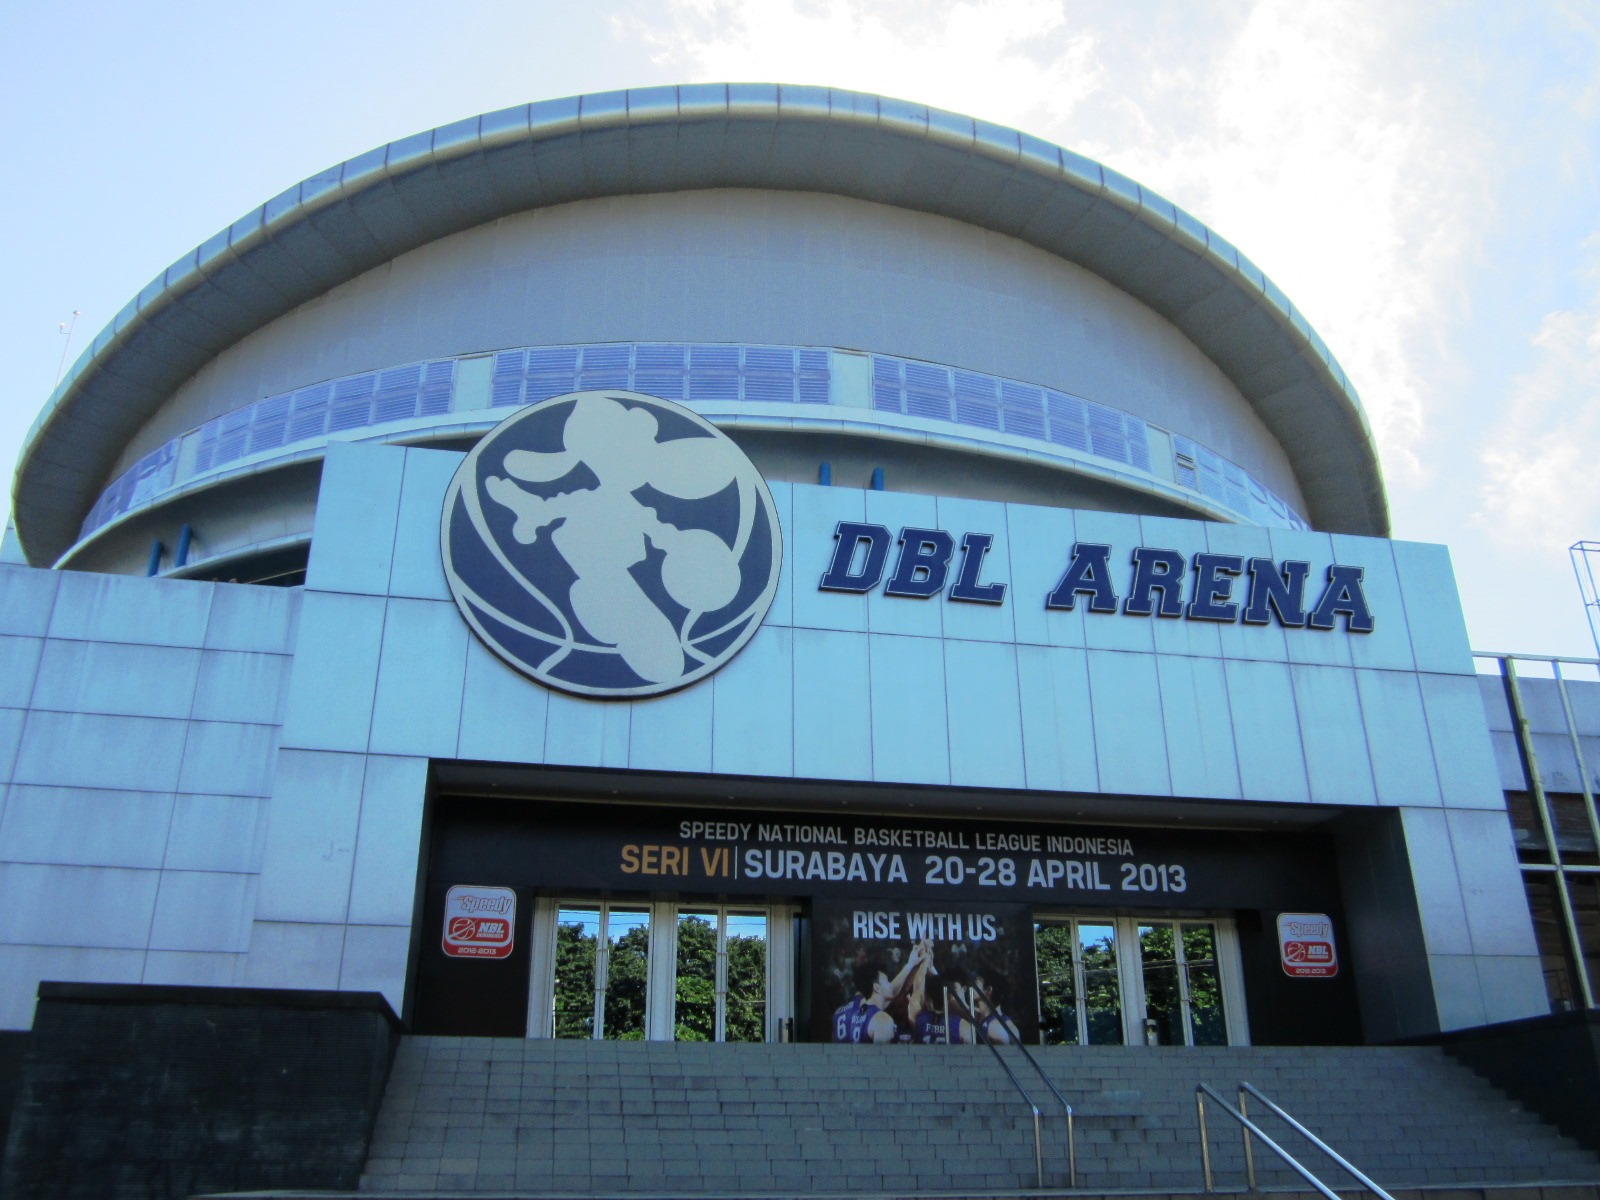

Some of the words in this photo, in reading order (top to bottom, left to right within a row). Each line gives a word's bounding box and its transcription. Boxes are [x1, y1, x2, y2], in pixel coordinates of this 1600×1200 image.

[818, 520, 1007, 605] DBL
[1047, 542, 1375, 633] ARENA
[679, 821, 752, 841] SPEEDY
[758, 824, 848, 845] NATIONAL
[854, 827, 970, 849] BASKETBALL
[976, 833, 1041, 852] LEAGUE
[1047, 836, 1134, 856] INDONESIA
[620, 844, 689, 876] SERI
[700, 847, 729, 877] VI
[744, 849, 908, 883] SURABAYA
[925, 855, 1017, 887] 20-28
[1027, 859, 1111, 891] APRIL
[1120, 863, 1187, 893] 2013
[460, 895, 512, 914] Speedy
[478, 922, 504, 933] NBL
[853, 911, 901, 940] RISE
[906, 912, 962, 941] WITH
[968, 914, 997, 941] US
[1290, 922, 1329, 938] Speedy
